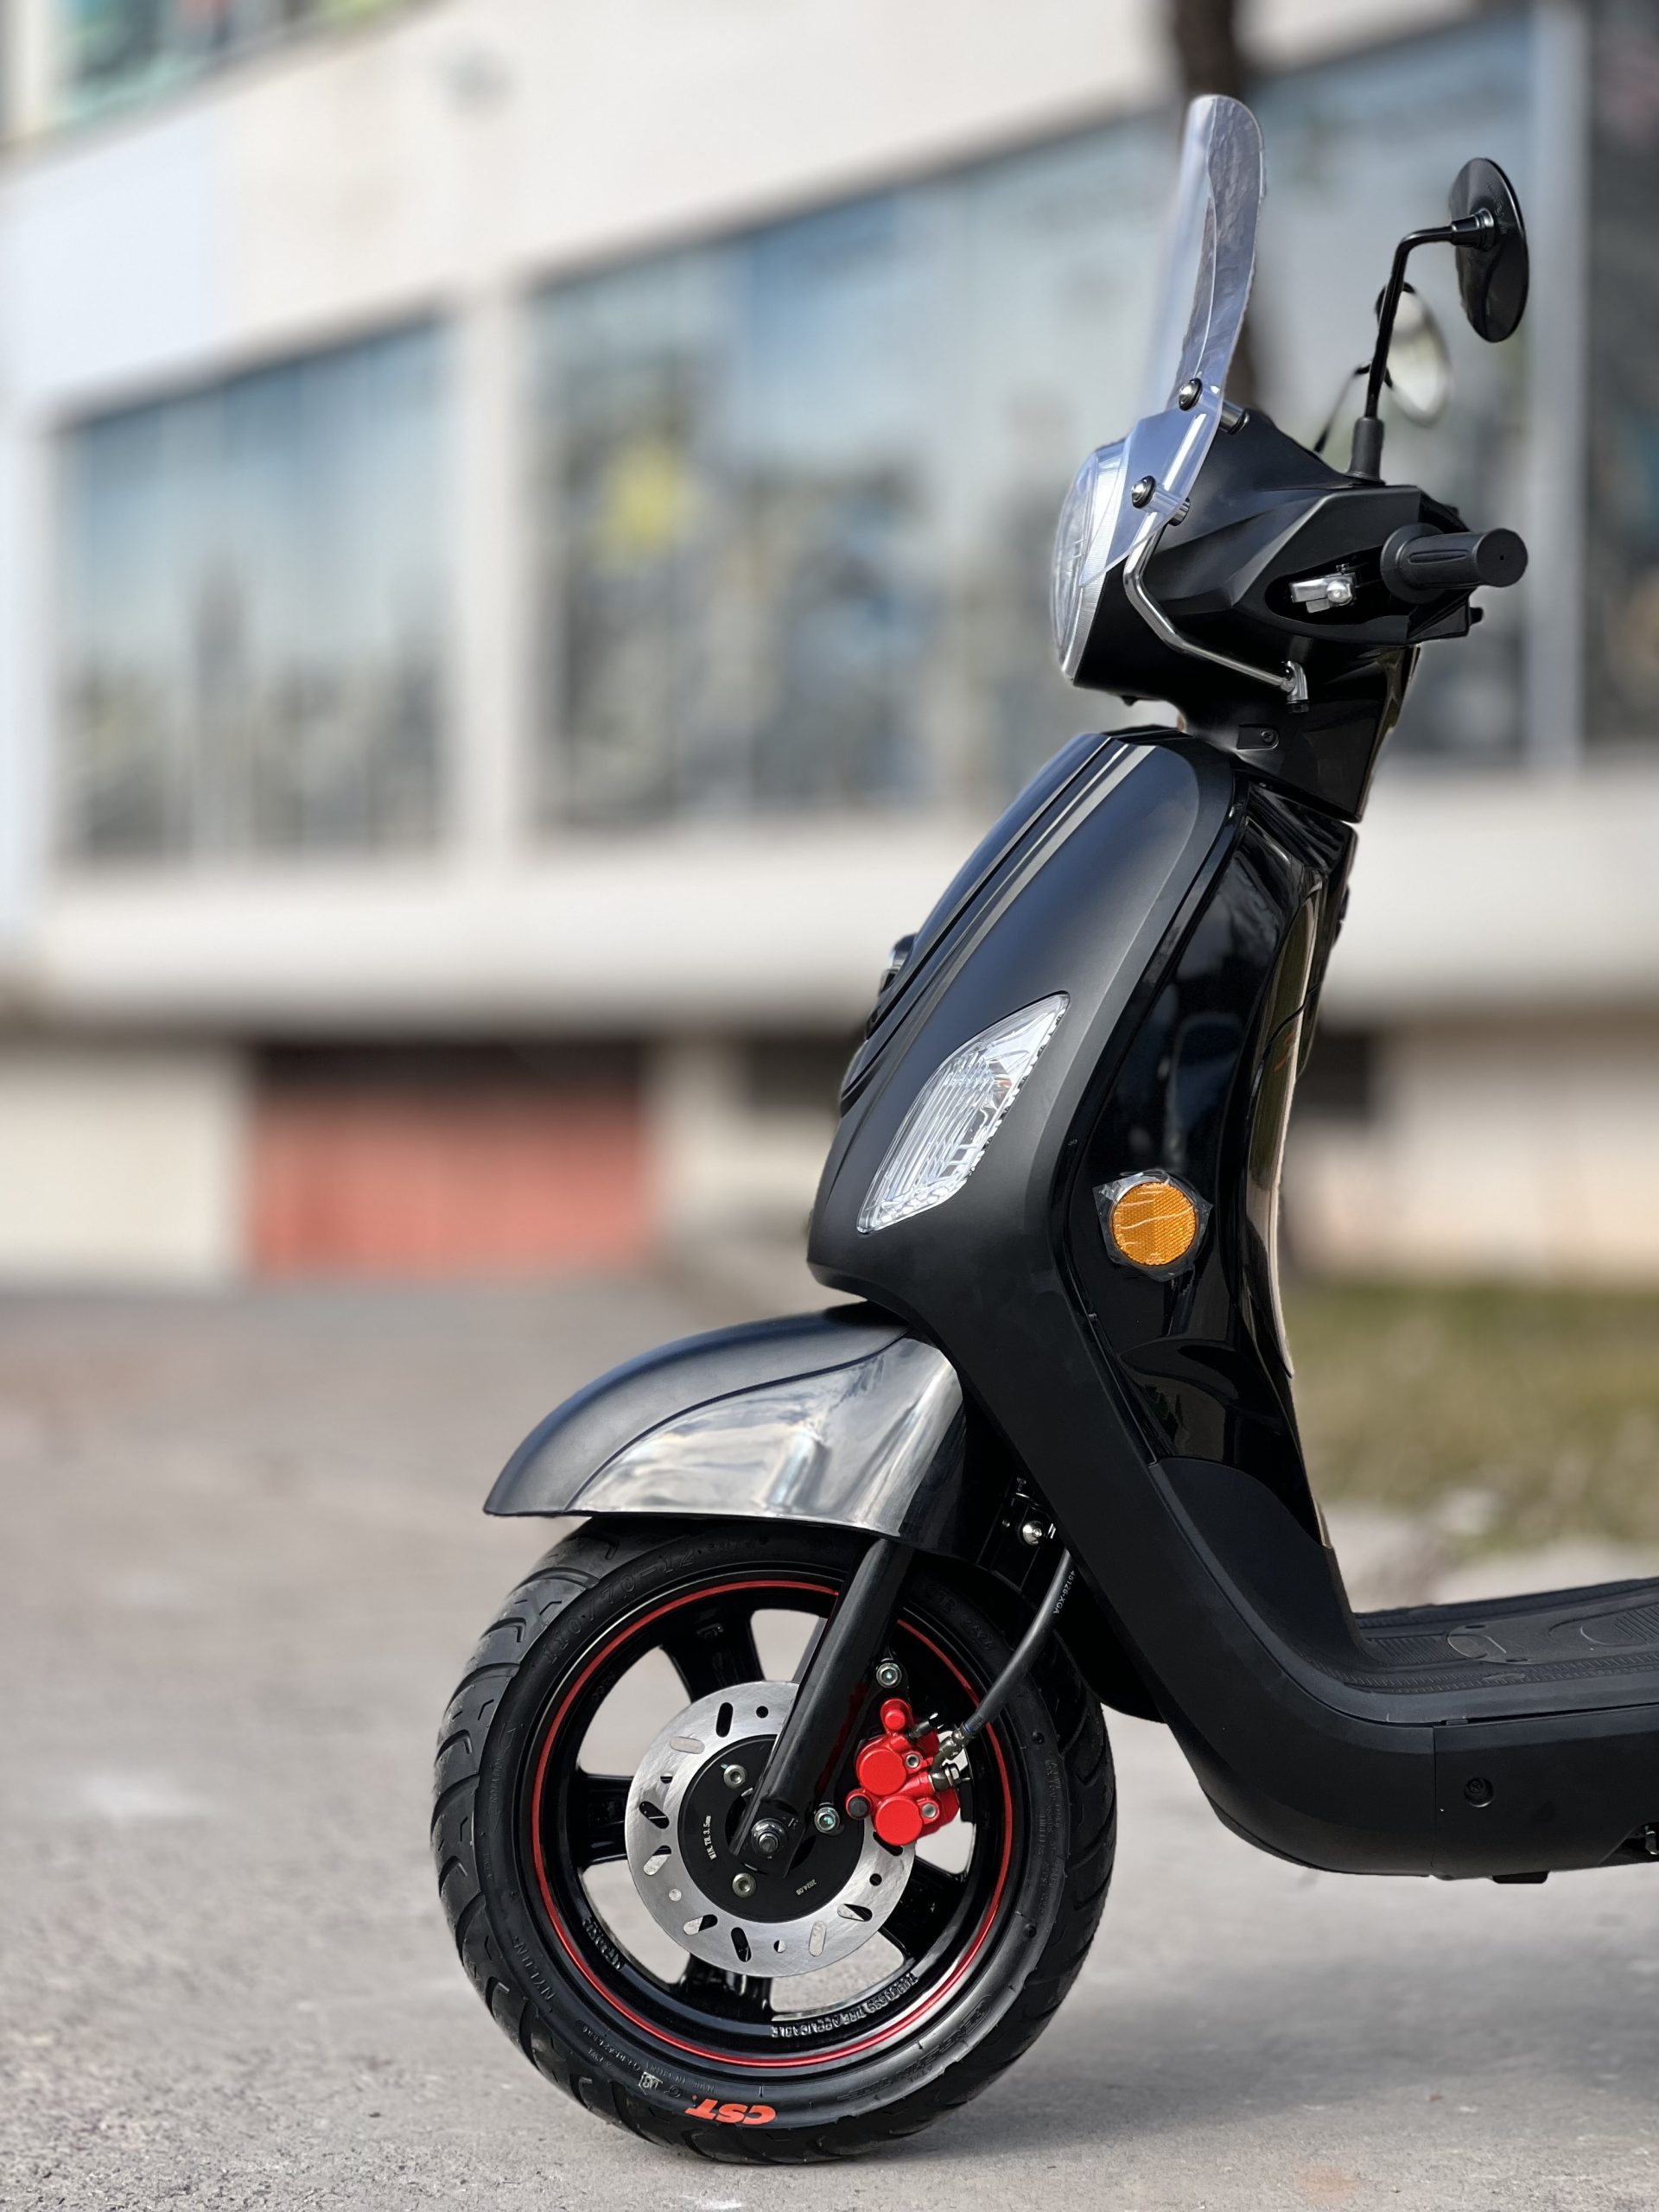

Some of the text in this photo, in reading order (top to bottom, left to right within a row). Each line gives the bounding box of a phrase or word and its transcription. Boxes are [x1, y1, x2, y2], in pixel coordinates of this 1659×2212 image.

[541, 1548, 696, 1666] 110/70-12
[513, 1942, 556, 2001] NYLON
[684, 2097, 777, 2126] CST
